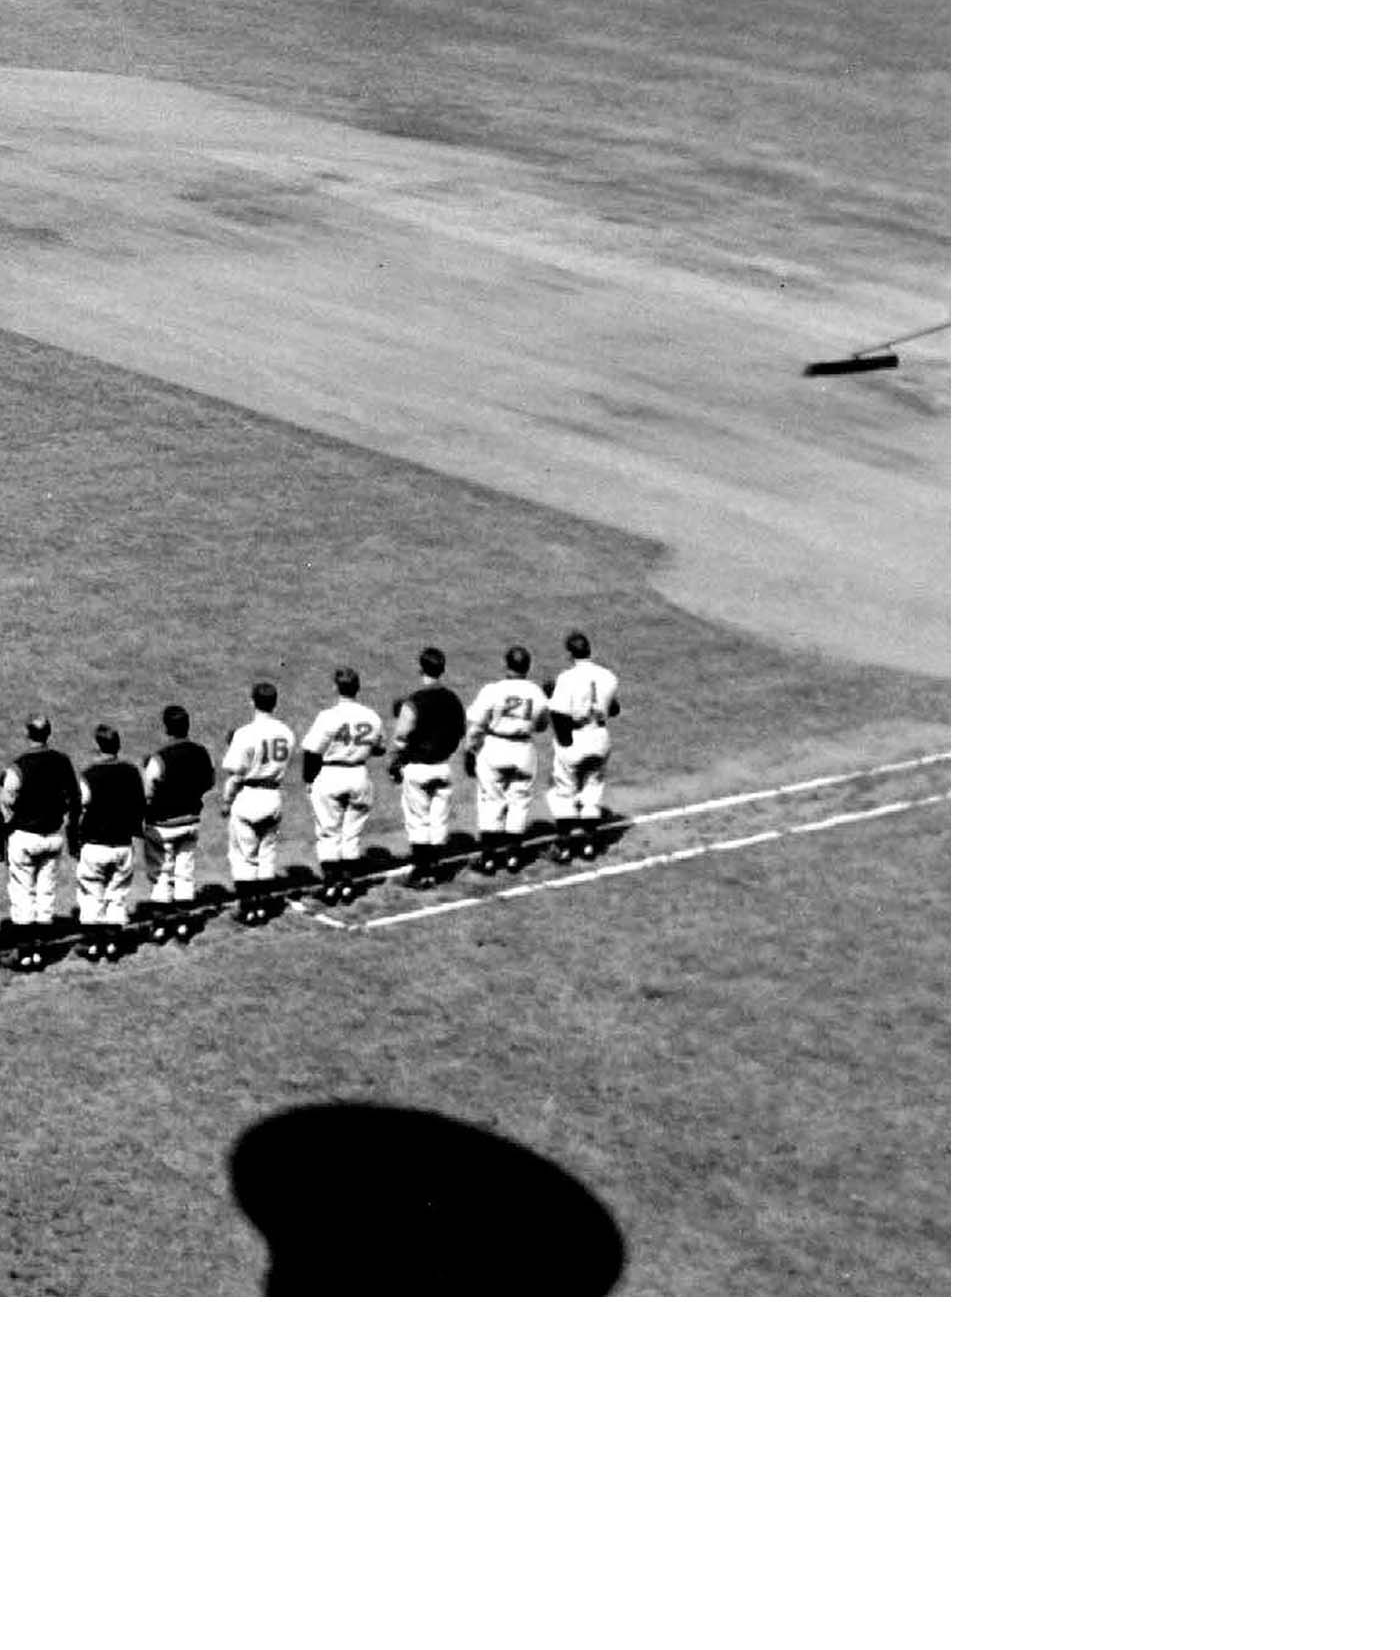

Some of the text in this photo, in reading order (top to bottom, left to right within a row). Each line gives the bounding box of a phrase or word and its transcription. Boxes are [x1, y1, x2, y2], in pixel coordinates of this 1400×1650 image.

[501, 695, 533, 720] 21
[334, 722, 374, 747] 42
[261, 738, 289, 765] 16
